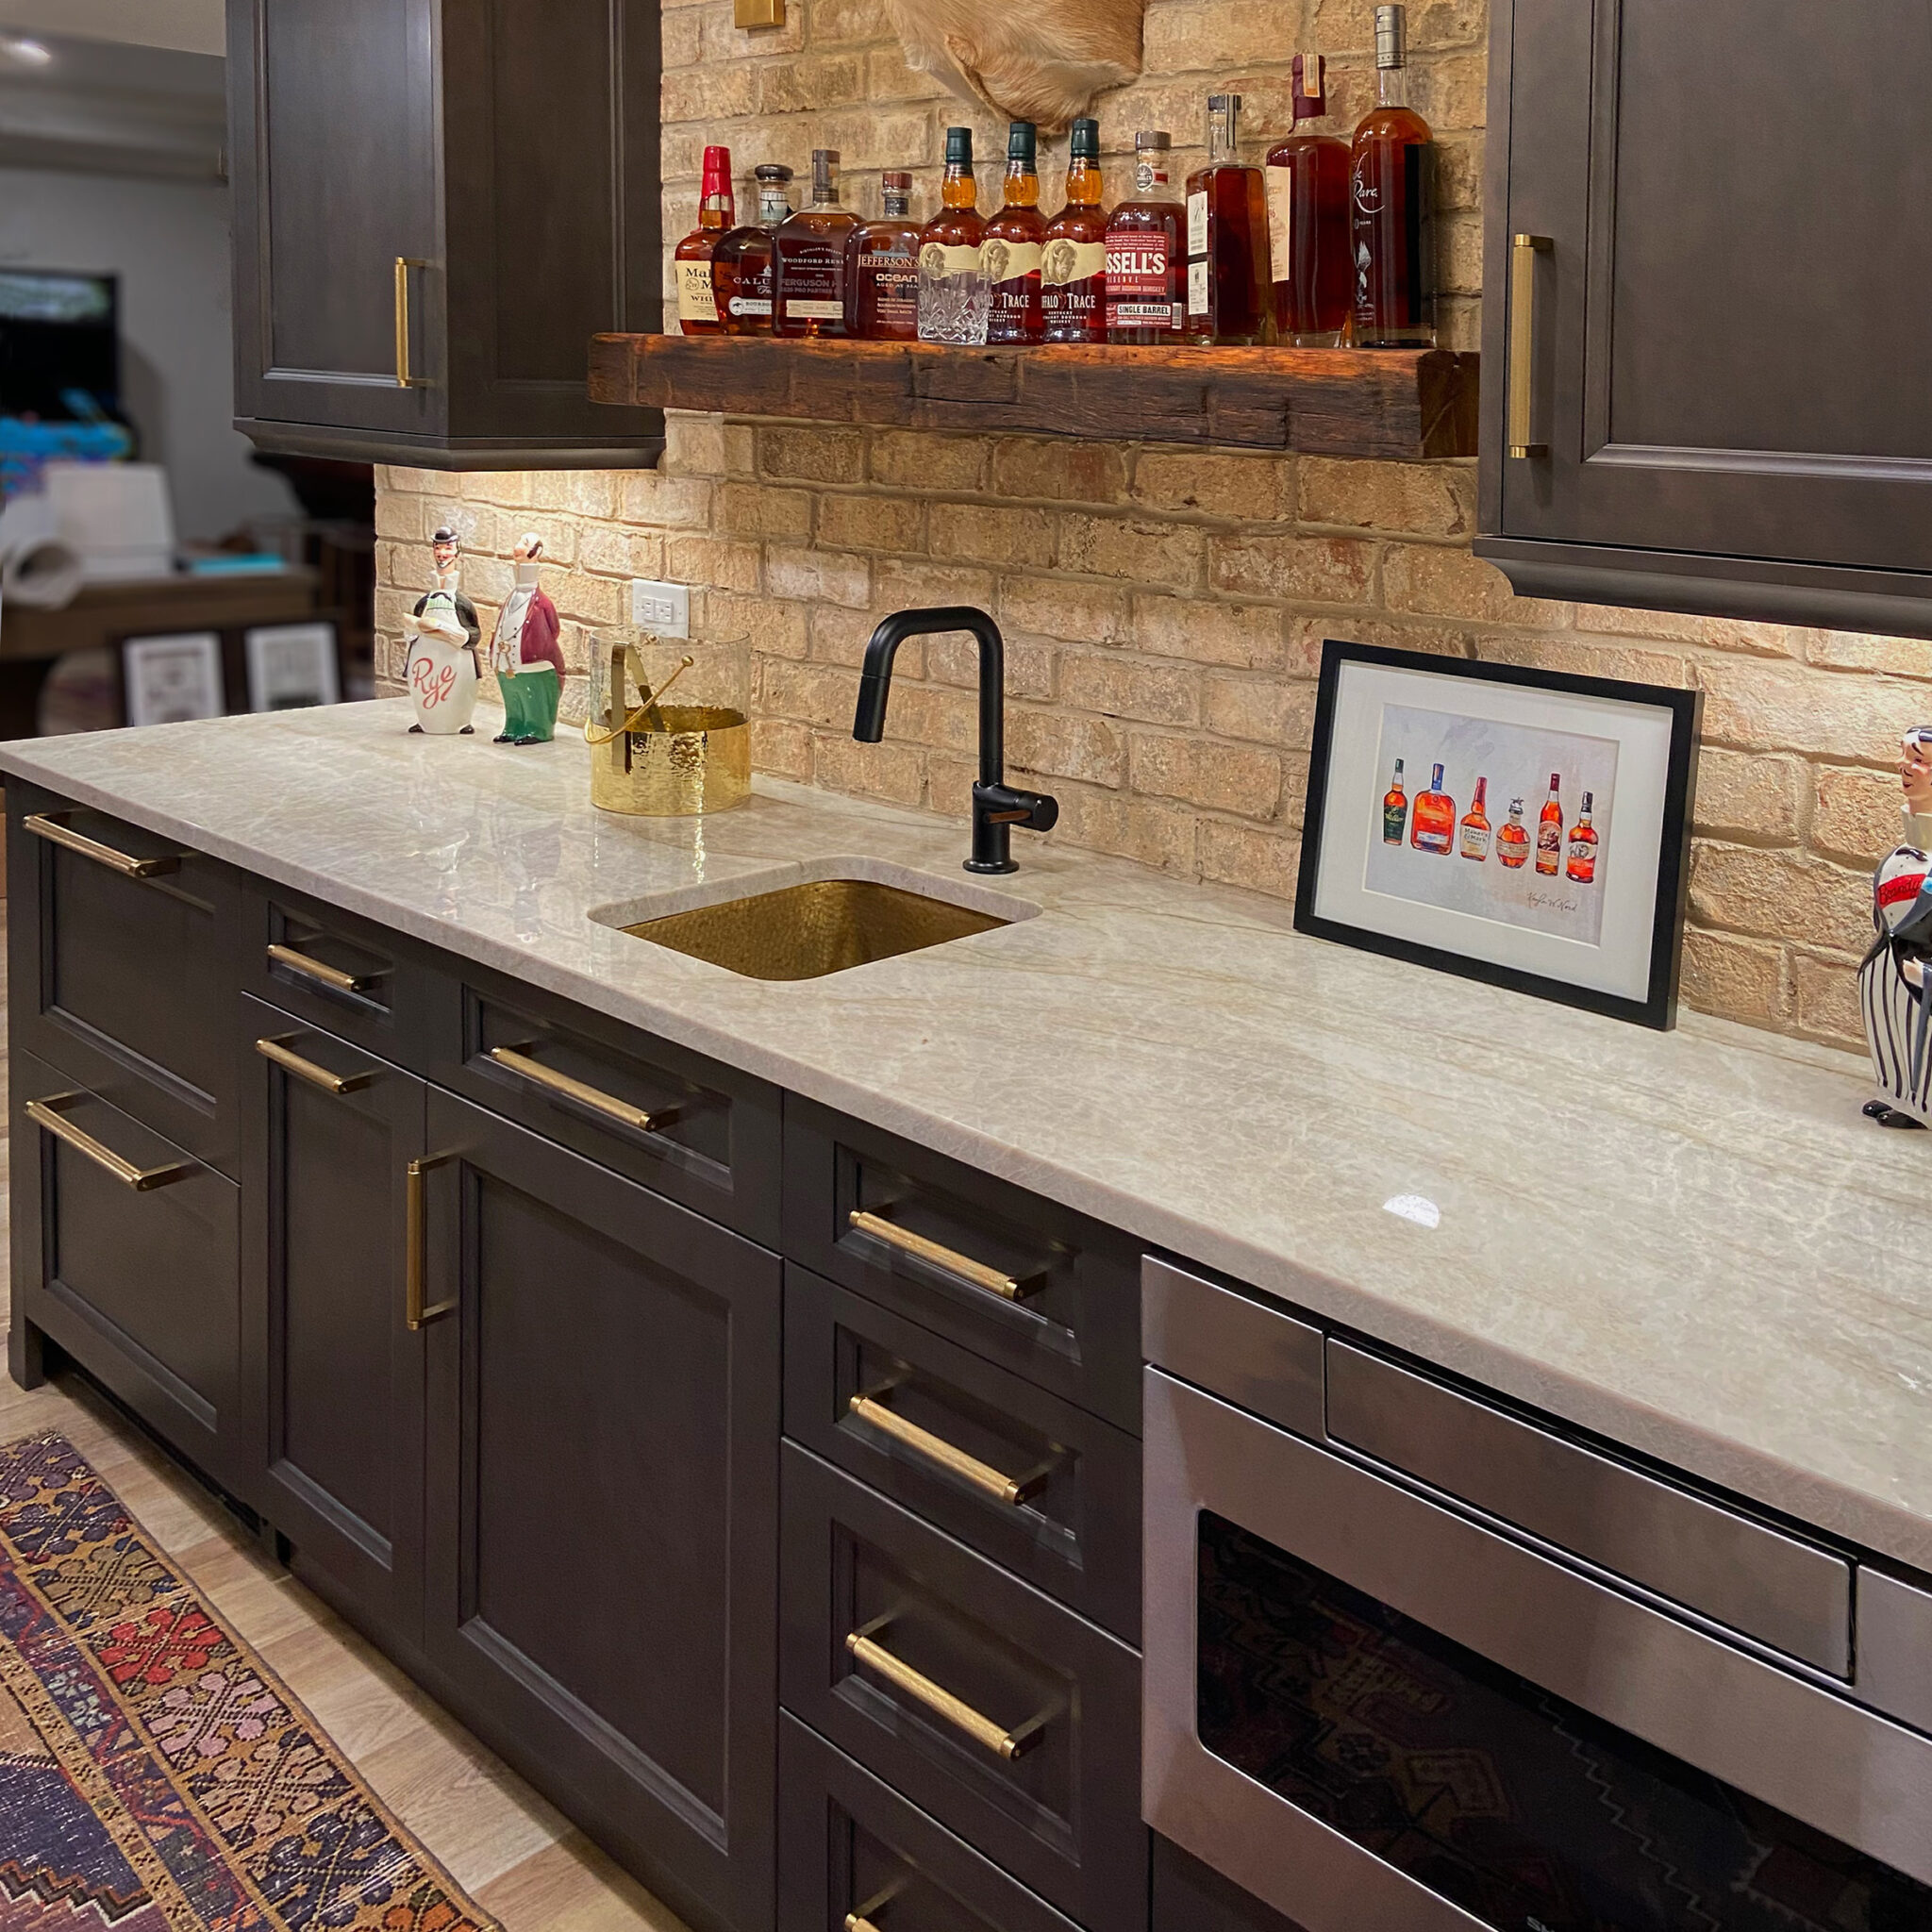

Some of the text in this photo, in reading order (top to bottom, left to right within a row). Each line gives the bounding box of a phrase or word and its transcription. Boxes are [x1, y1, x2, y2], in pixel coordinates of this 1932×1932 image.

[858, 254, 921, 268] JEFFERSON'S
[1002, 292, 1030, 308] TRACE
[1067, 292, 1096, 309] TRACE
[1119, 306, 1169, 315] SINGLE BARREL
[412, 657, 458, 709] Rye
